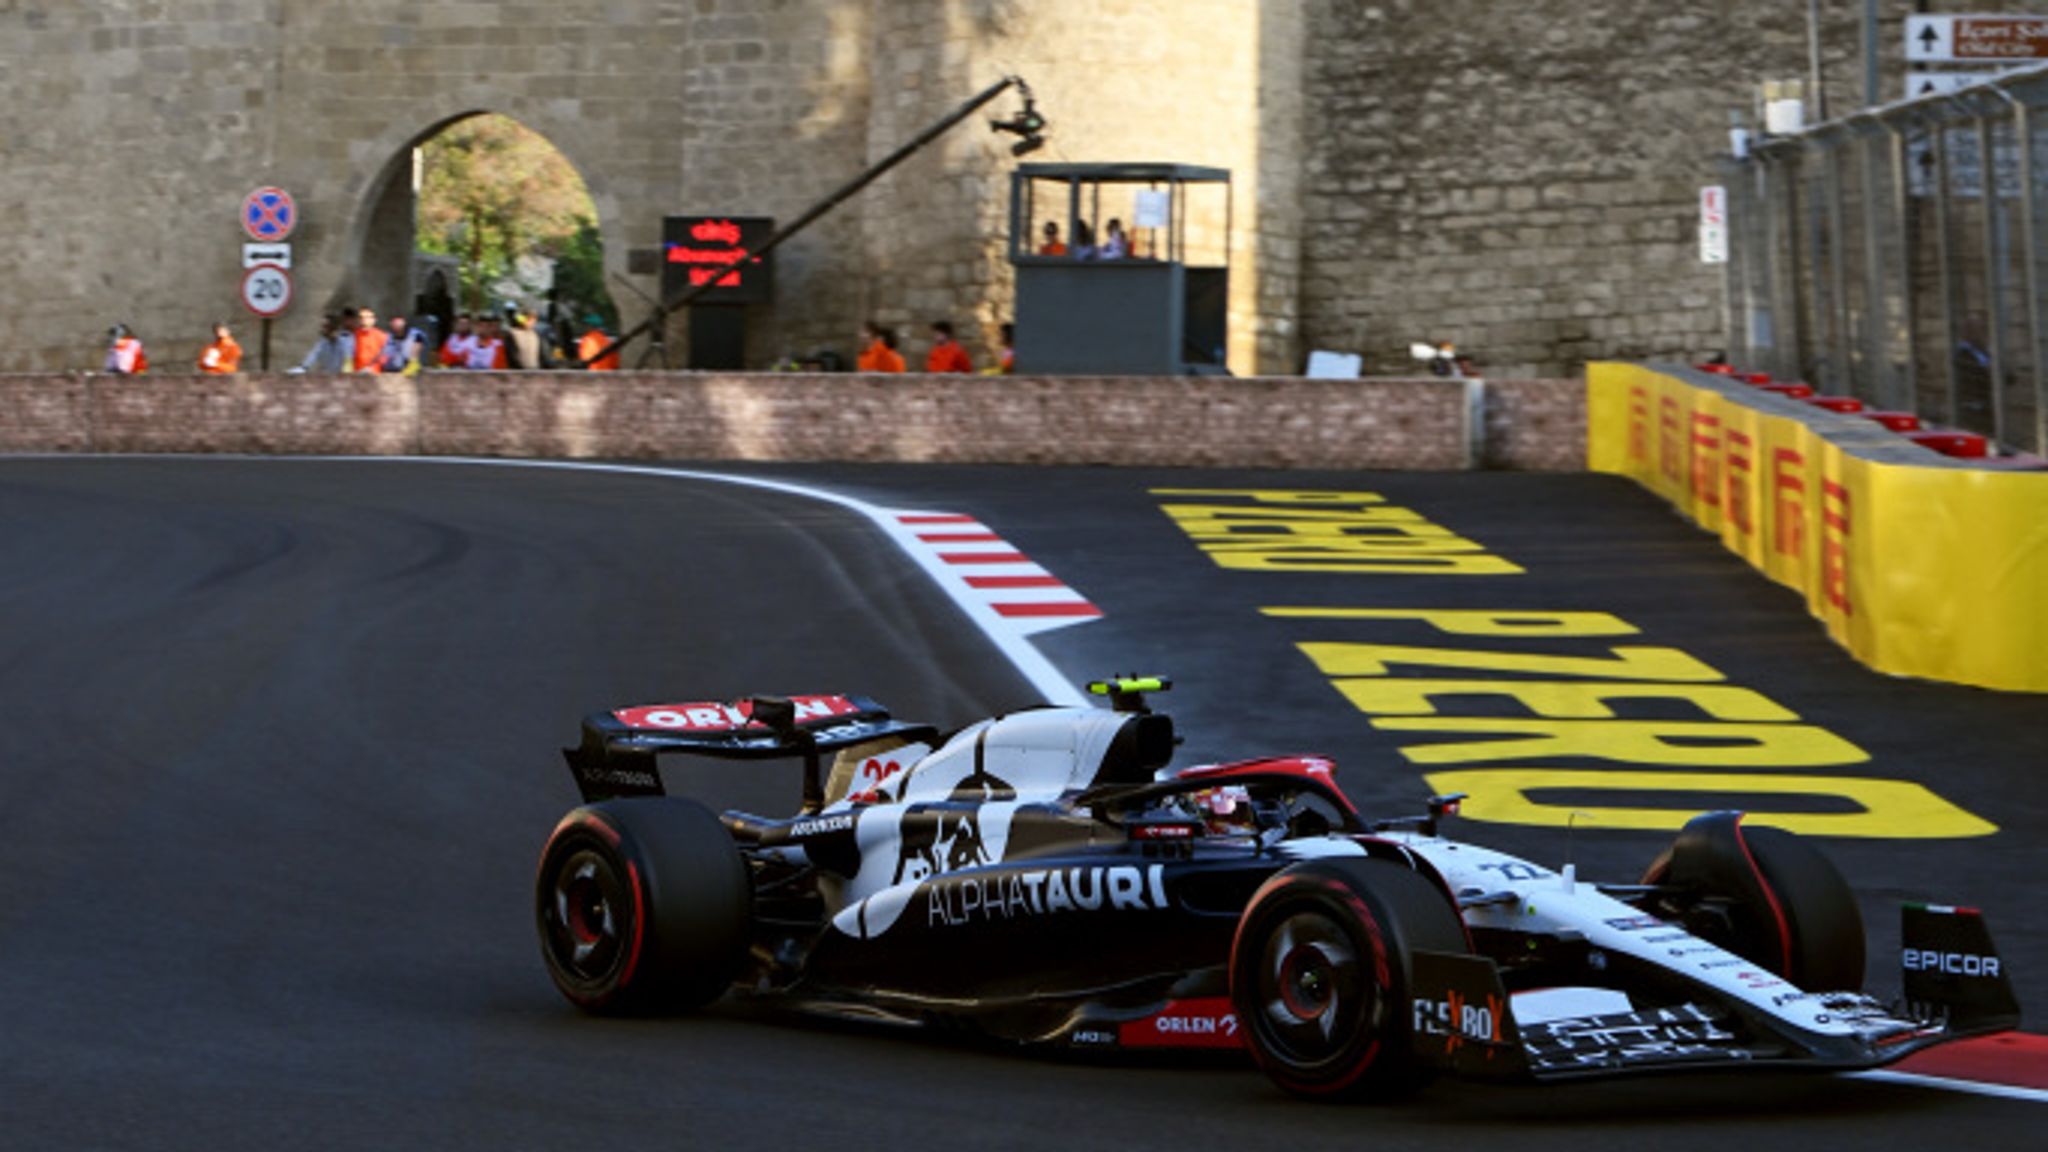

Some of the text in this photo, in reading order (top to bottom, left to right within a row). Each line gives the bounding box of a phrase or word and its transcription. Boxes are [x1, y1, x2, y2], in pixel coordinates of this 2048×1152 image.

[254, 279, 282, 299] 20
[928, 863, 1170, 928] ALPHATAURI
[1156, 1016, 1216, 1033] ORLEN
